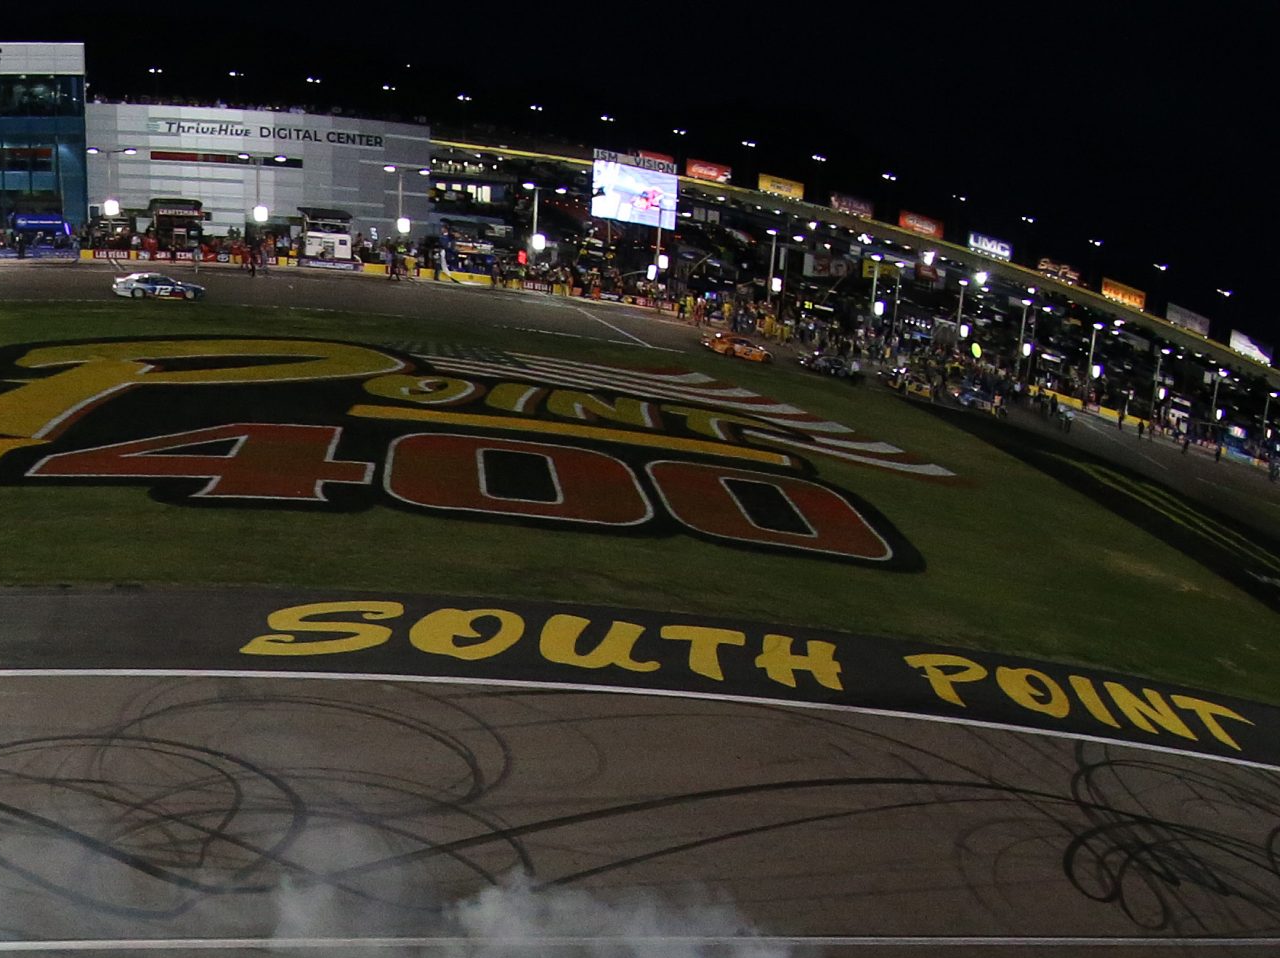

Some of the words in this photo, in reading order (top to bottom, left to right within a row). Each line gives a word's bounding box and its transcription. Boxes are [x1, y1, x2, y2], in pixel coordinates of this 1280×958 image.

[260, 126, 322, 143] DIGITAL
[327, 131, 384, 148] CENTER
[596, 151, 618, 162] ISM
[634, 156, 675, 173] VISION
[108, 251, 128, 259] VEGAS
[154, 285, 174, 295] 12
[23, 423, 894, 561] 400
[238, 601, 844, 692] SOUTH
[904, 652, 1255, 751] POINT
